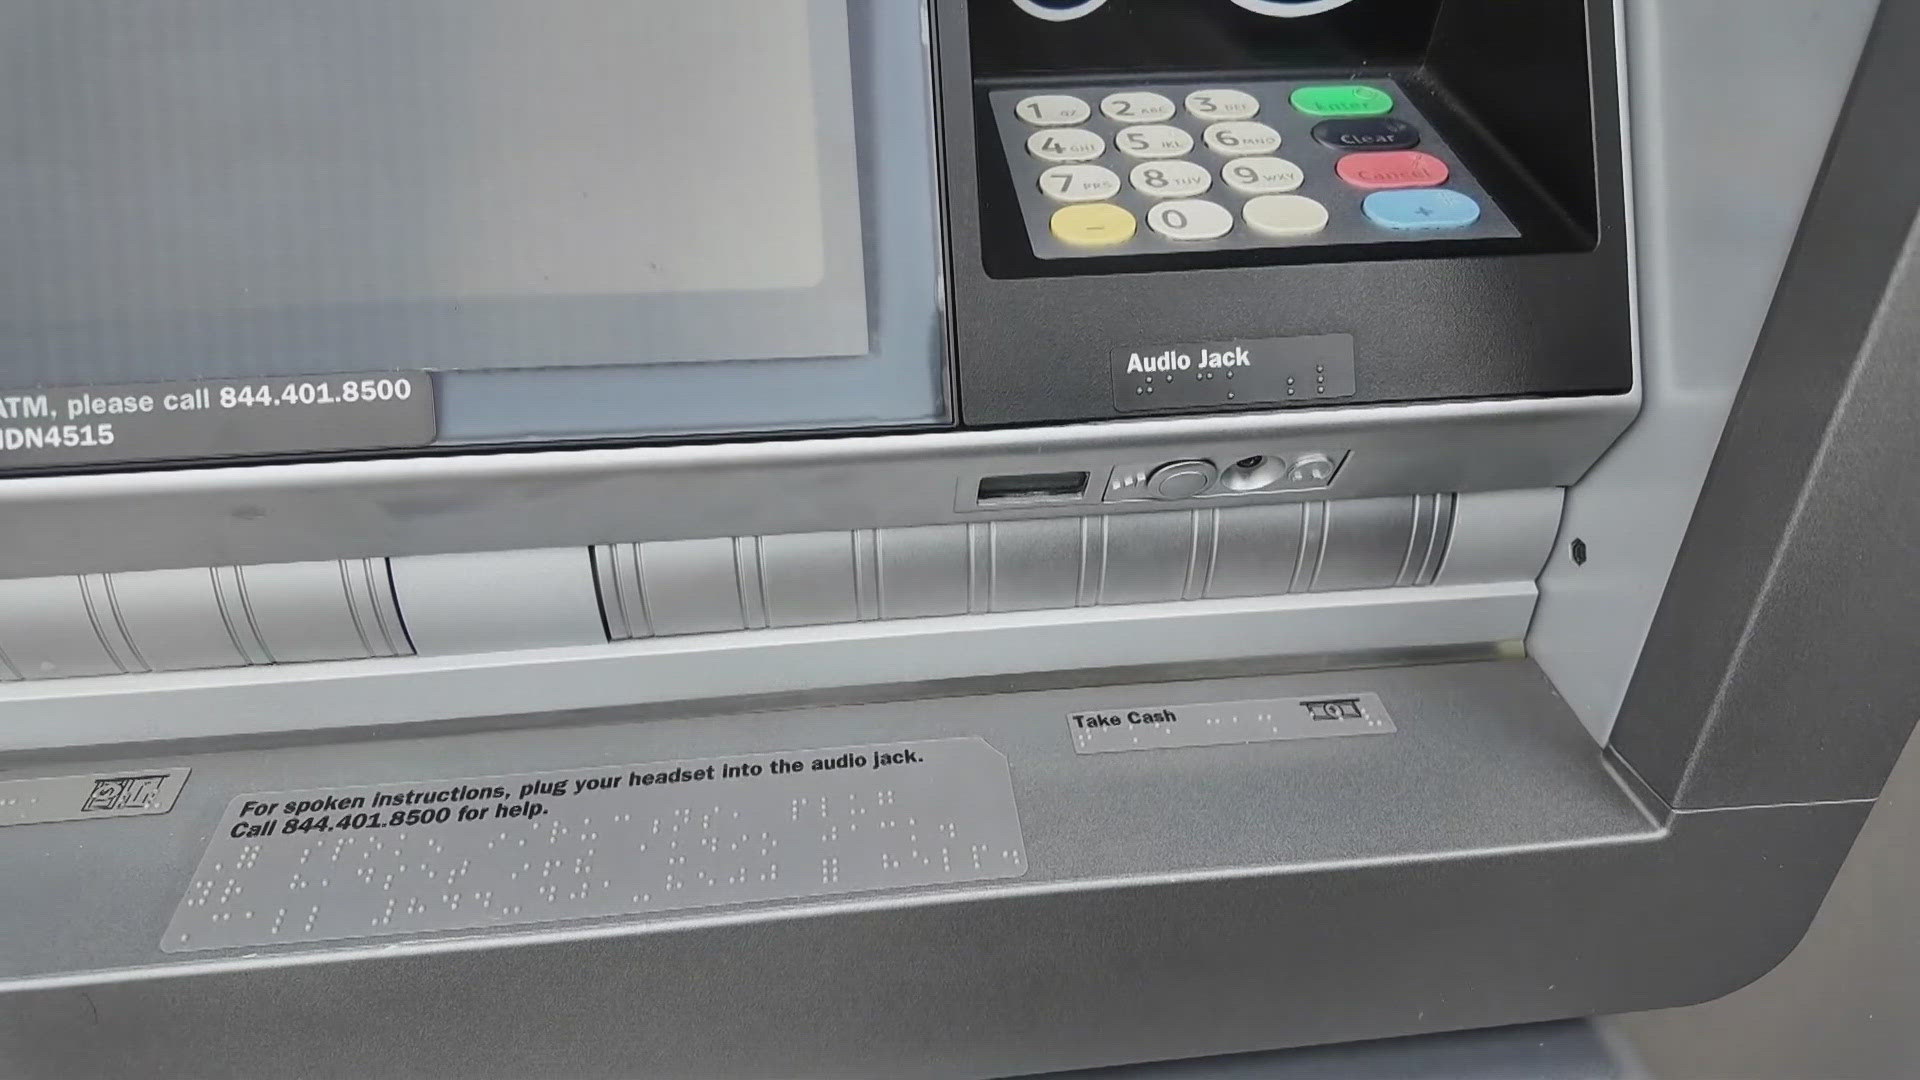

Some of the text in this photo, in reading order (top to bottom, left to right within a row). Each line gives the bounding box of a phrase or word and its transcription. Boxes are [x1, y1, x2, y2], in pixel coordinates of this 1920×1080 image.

[1026, 103, 1043, 119] 1
[1111, 101, 1135, 116] 2
[1193, 97, 1218, 112] 3
[1315, 101, 1368, 112] Enter
[1042, 137, 1066, 154] 4
[1126, 132, 1150, 150] 5
[1215, 129, 1240, 146] 6
[1340, 133, 1395, 144] Clear
[1050, 173, 1074, 193] 7
[1143, 169, 1170, 188] 8
[1233, 166, 1259, 184] 9
[1358, 168, 1432, 181] Cancel
[1161, 209, 1188, 229] 0
[1126, 346, 1251, 374] Audio Jack
[67, 393, 154, 420] please
[163, 387, 210, 412] call
[219, 378, 412, 408] 844.401.8500
[1072, 709, 1177, 728] Take Cash
[239, 749, 924, 818] For spoken instructions, plug your headset into the audio jack.
[230, 801, 549, 839] Call 844.401.8500 for help.
